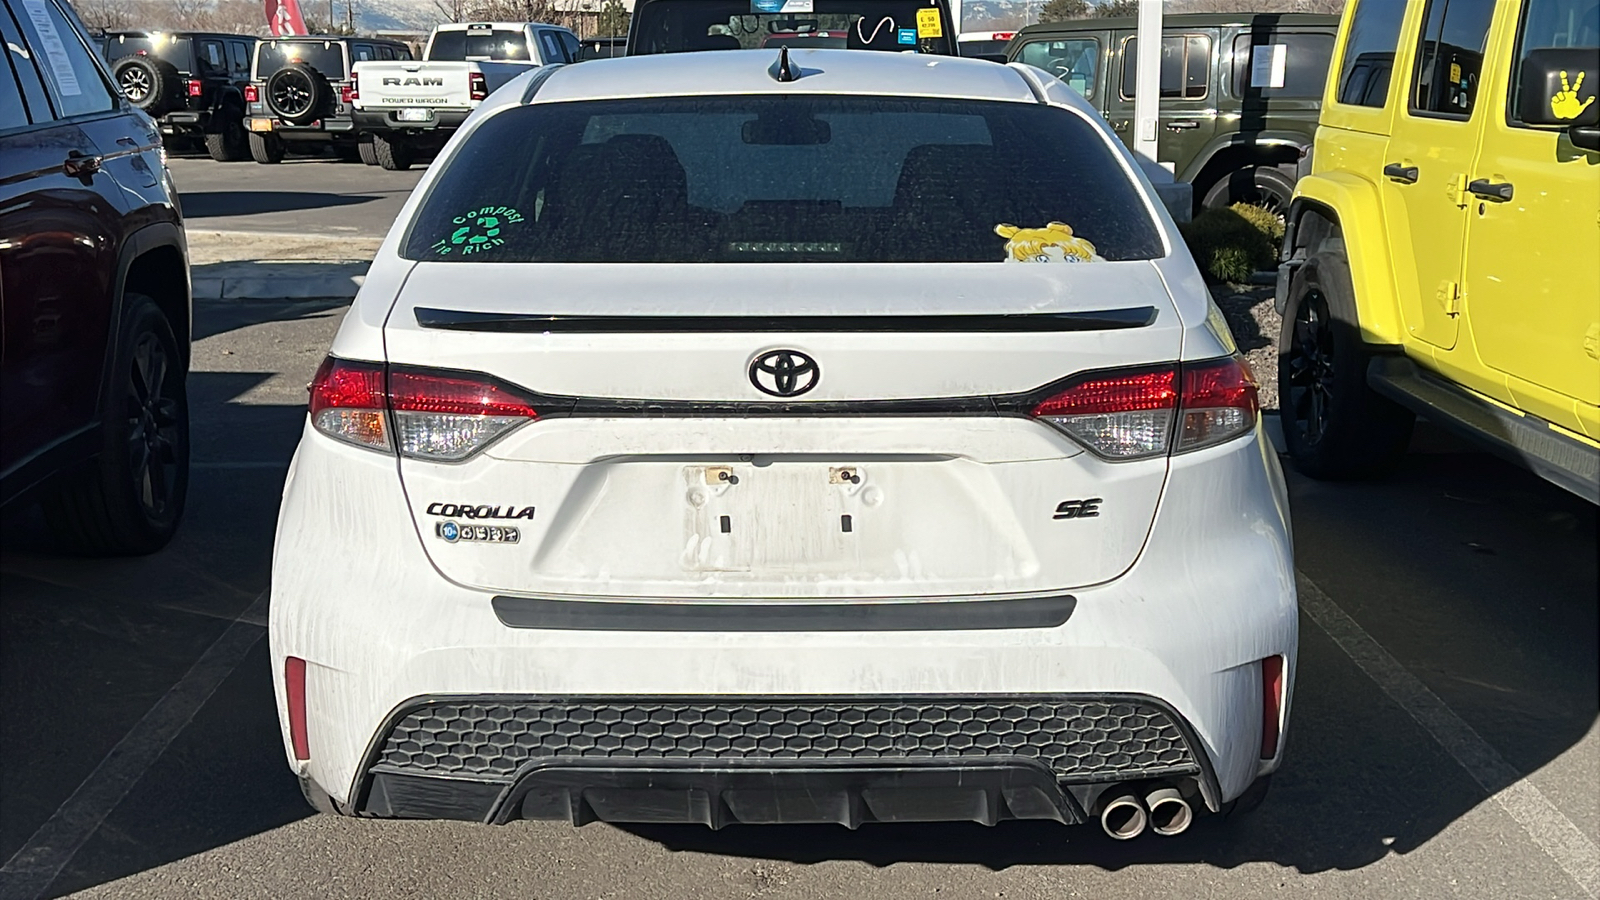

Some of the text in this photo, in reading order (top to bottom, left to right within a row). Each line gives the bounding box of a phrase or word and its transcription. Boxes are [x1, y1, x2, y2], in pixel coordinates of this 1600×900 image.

[382, 77, 443, 86] RAM
[452, 206, 525, 224] Compost
[462, 238, 505, 255] Rich
[426, 502, 536, 520] COROLLA
[1052, 497, 1104, 520] SE
